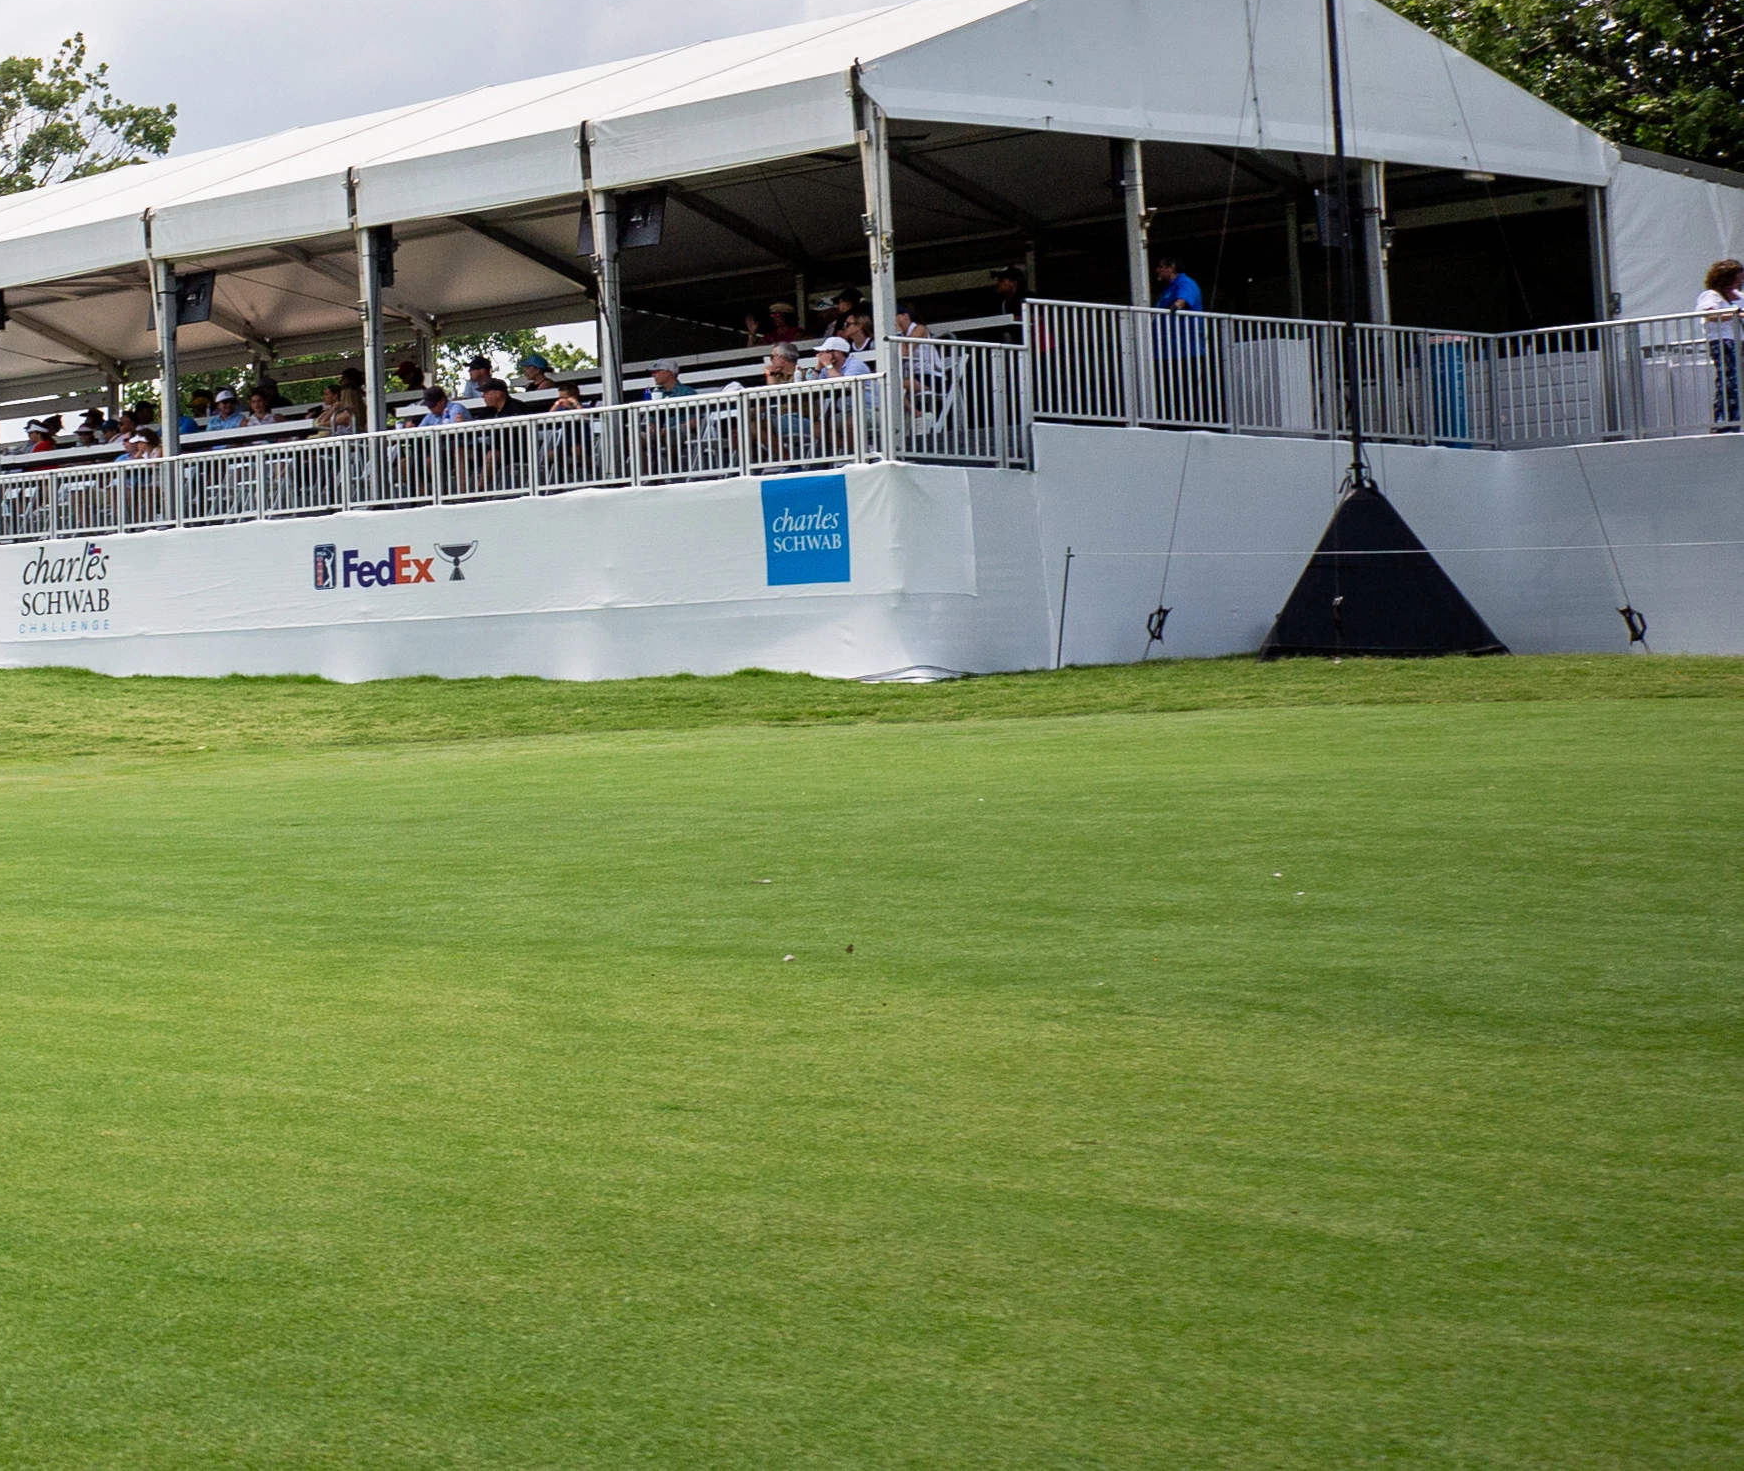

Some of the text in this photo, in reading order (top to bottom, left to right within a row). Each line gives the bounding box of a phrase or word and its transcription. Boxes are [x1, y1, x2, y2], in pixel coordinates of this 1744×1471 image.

[772, 504, 840, 533] charles
[773, 533, 842, 554] SCHWAB
[23, 541, 110, 585] charles
[342, 545, 436, 588] FedEx
[21, 588, 110, 617] SCHWAB
[18, 619, 110, 634] CHALLENGE
